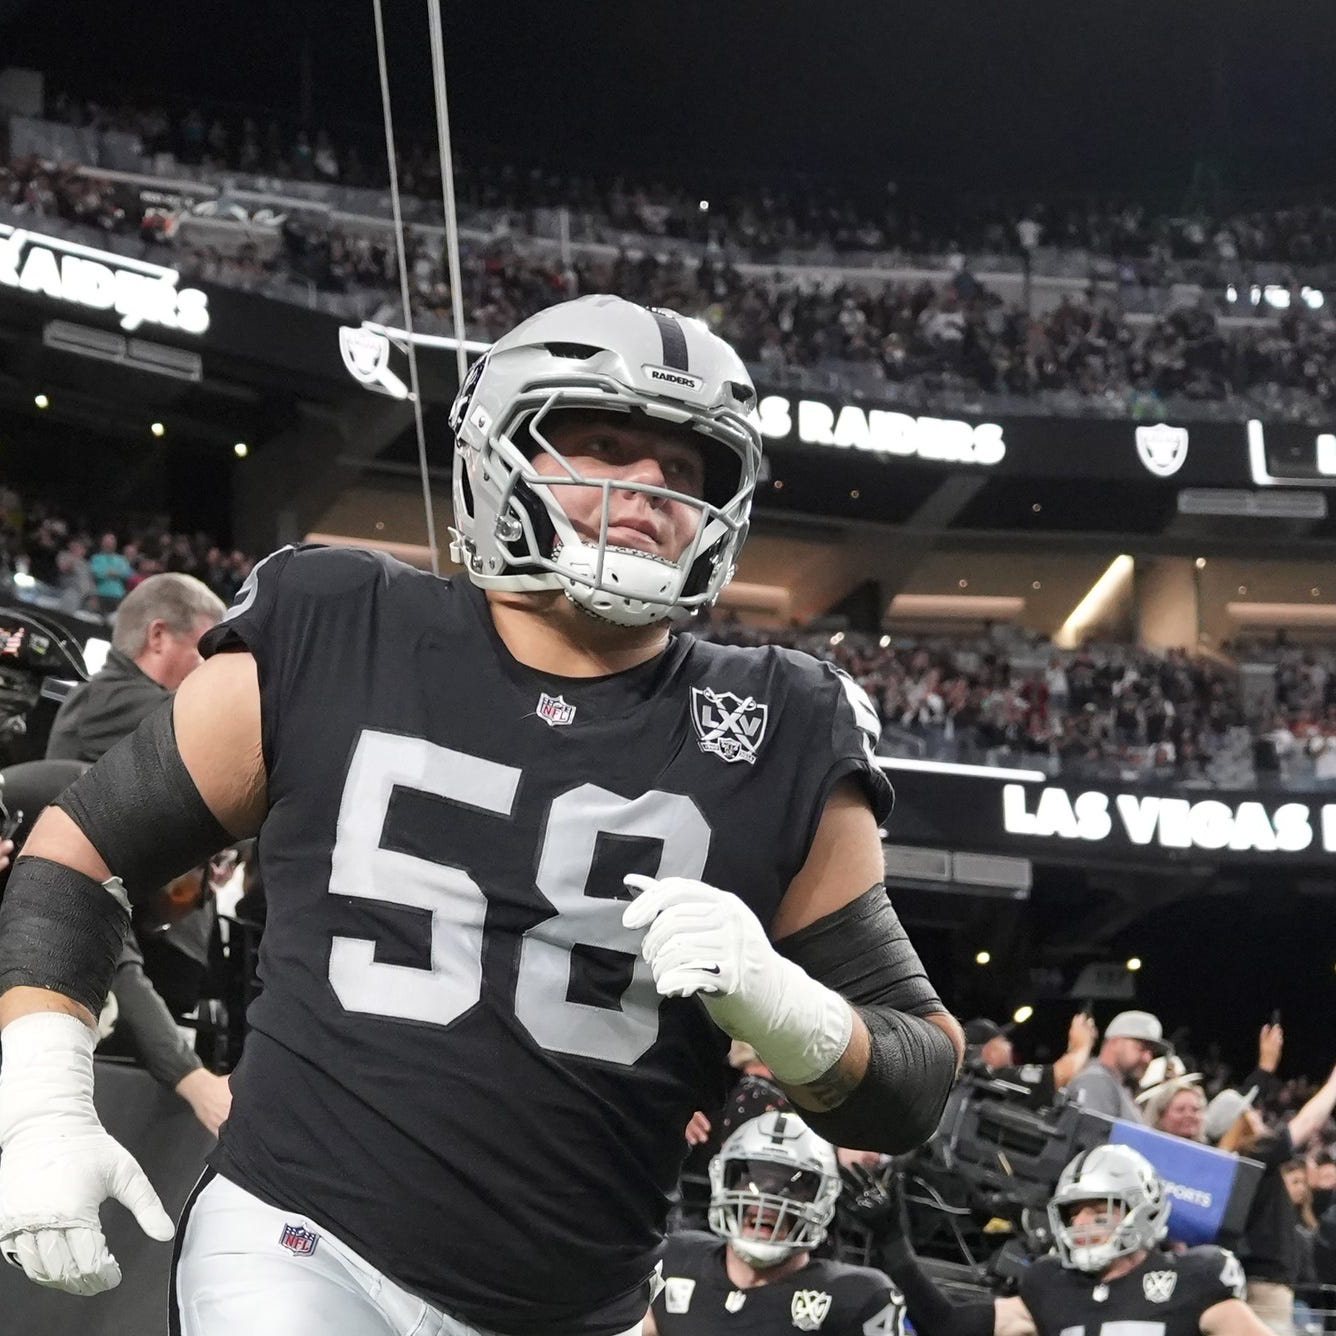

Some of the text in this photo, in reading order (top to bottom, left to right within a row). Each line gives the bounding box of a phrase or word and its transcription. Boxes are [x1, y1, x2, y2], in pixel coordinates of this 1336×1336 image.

[651, 370, 697, 389] RAIDERS
[798, 400, 1006, 465] RAIDERS
[701, 704, 762, 738] LXV
[1003, 784, 1112, 841] LAS
[1116, 794, 1313, 852] VEGAS
[327, 728, 713, 1067] 58
[1161, 1181, 1213, 1209] PORTS
